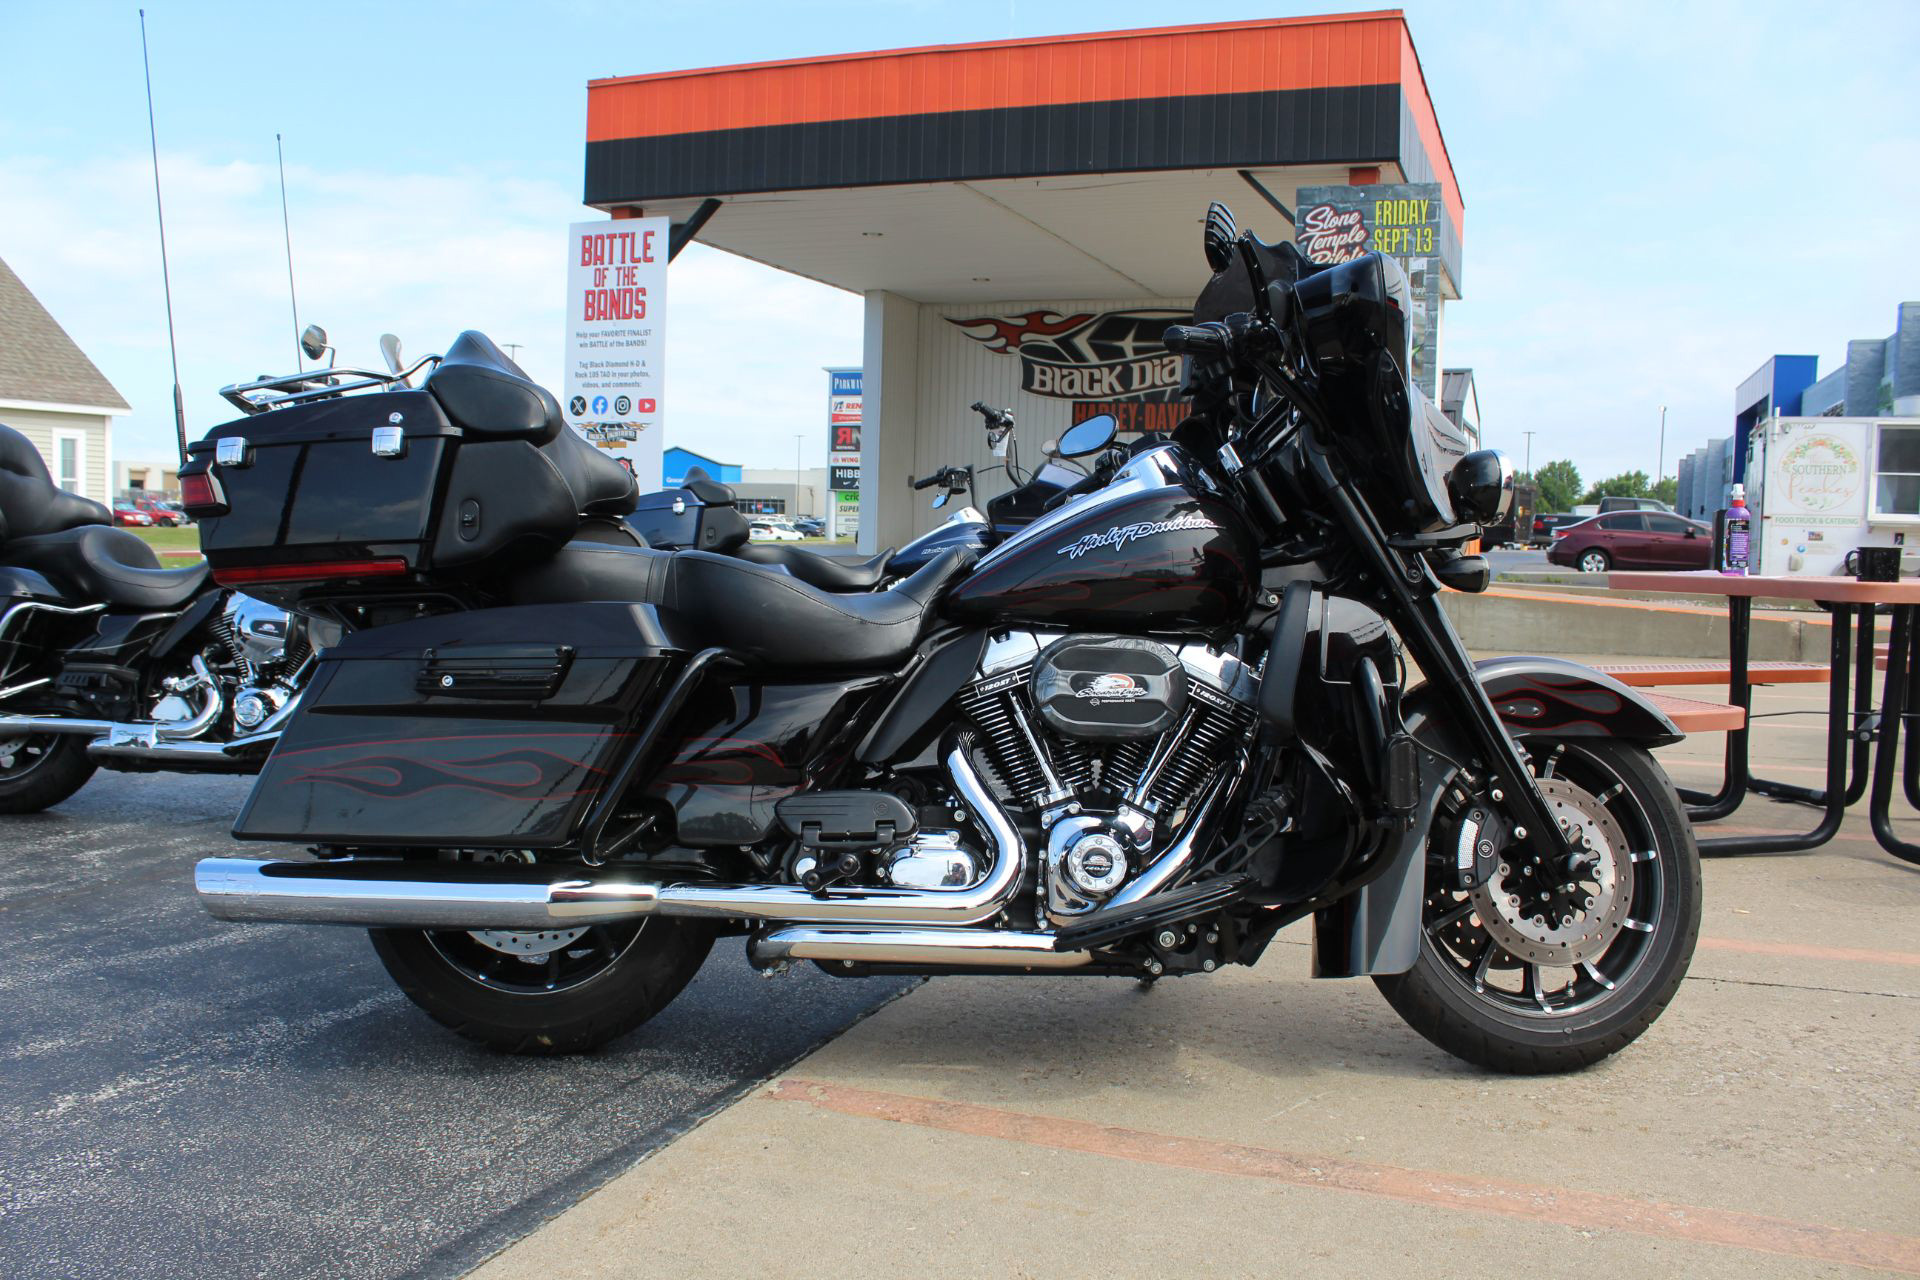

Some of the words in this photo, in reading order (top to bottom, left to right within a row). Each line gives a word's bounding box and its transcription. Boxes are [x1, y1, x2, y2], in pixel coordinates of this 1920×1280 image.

[1305, 206, 1361, 232] Stone
[1375, 199, 1428, 226] FRIDAY
[581, 231, 655, 267] BATTLE
[1298, 224, 1367, 257] Temple
[1374, 228, 1409, 253] SEPT
[1415, 227, 1433, 253] 13
[594, 267, 609, 287] OF
[615, 266, 638, 287] THE
[584, 287, 647, 321] BANDS
[601, 329, 626, 337] FAVORITE
[627, 329, 652, 337] FINALIST
[605, 360, 629, 368] Diamond
[1791, 464, 1848, 475] SOUTHERN
[1825, 517, 1859, 525] CATERING
